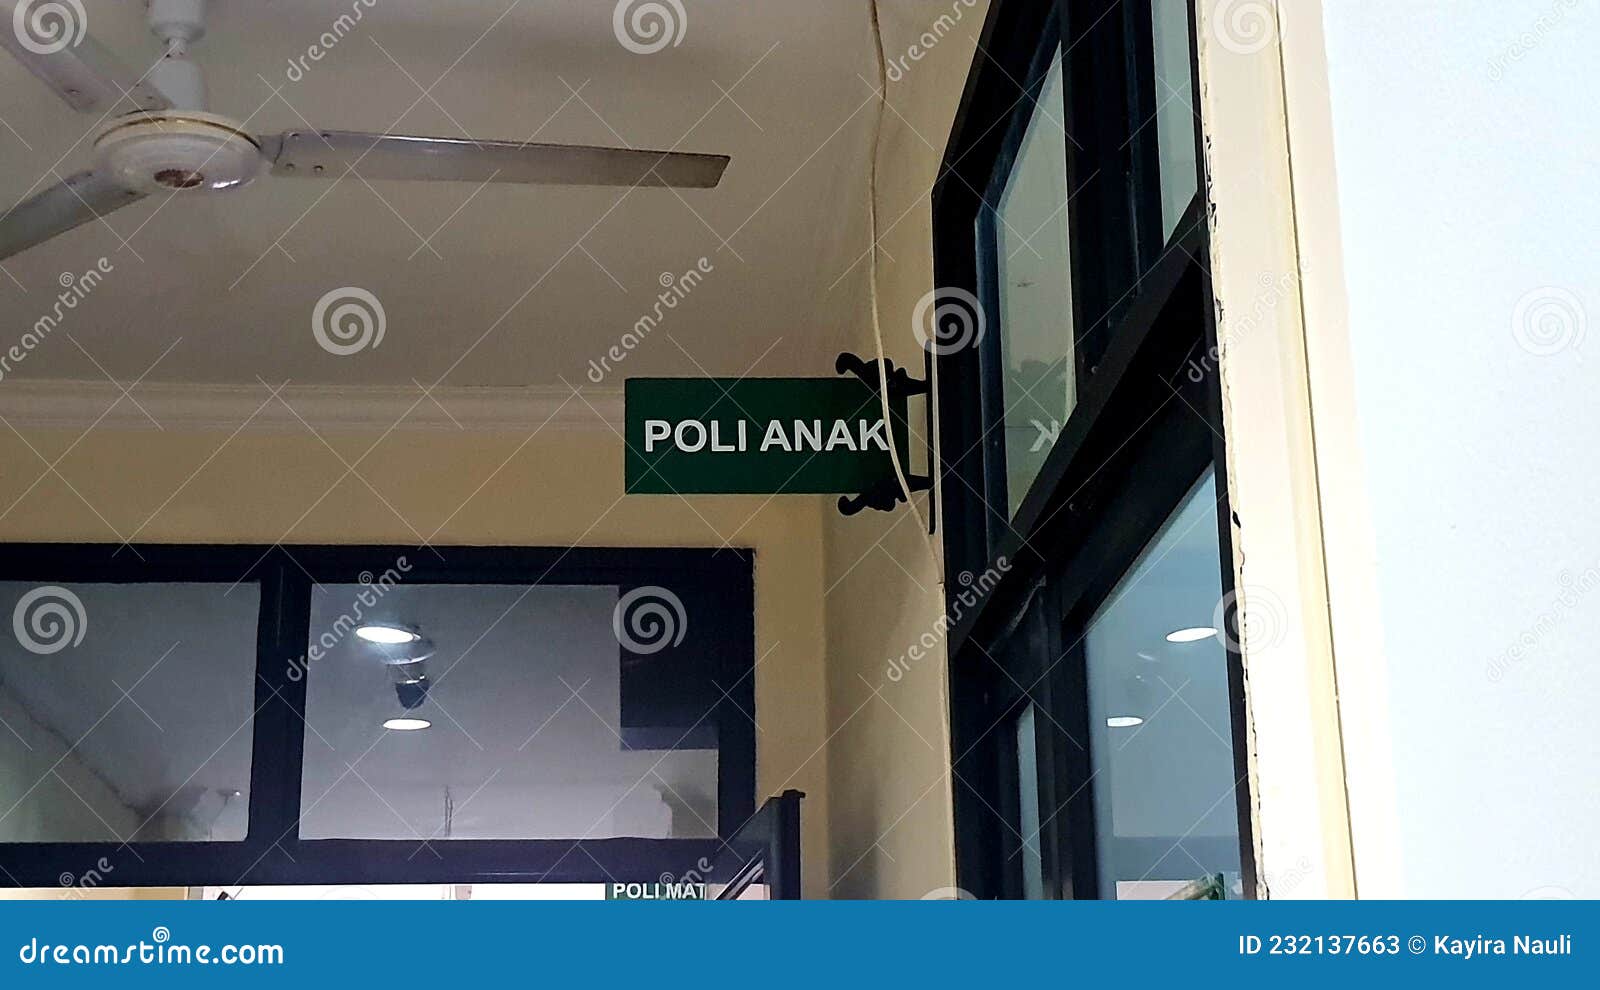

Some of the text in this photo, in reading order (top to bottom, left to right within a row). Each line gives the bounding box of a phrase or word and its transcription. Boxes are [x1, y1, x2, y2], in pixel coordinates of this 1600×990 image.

[644, 419, 891, 453] POLI ANAK
[613, 882, 660, 899] POLI
